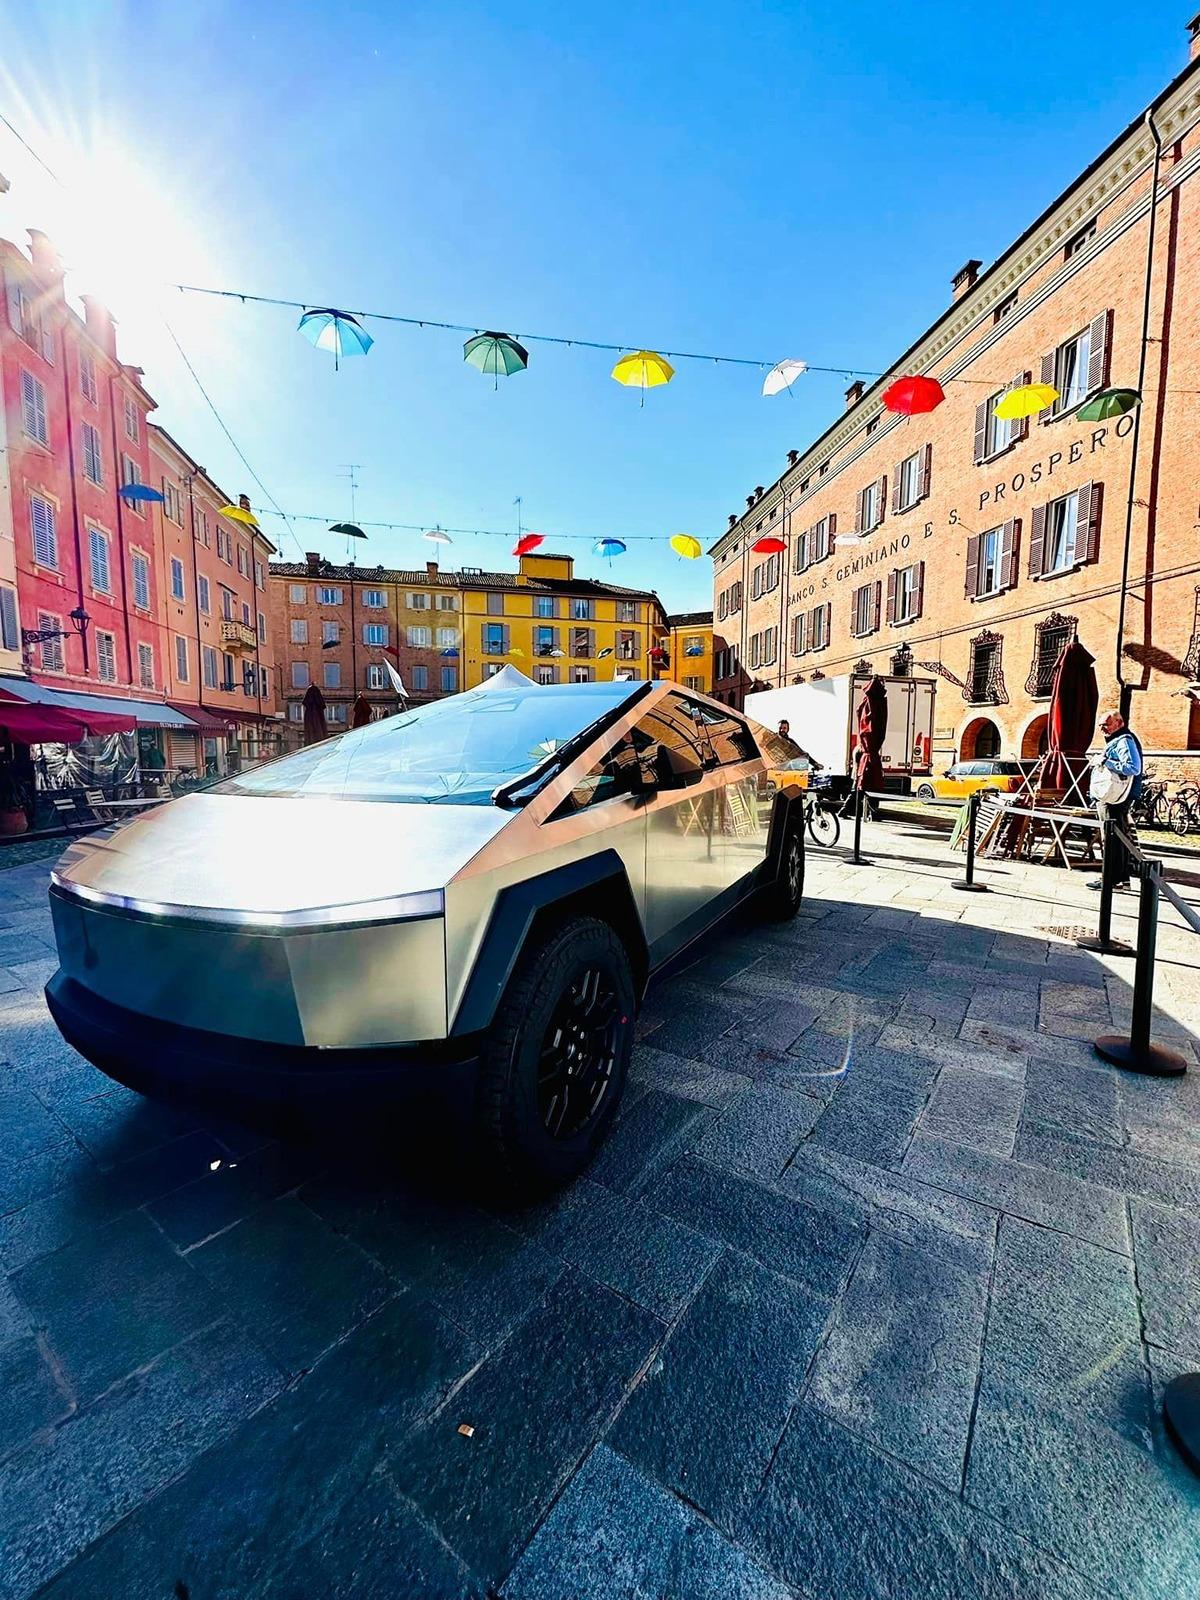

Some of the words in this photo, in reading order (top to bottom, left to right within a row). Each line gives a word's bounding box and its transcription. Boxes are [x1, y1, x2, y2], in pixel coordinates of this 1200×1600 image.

[836, 534, 911, 582] GEMINIANO
[923, 521, 934, 539] E
[948, 509, 962, 526] S.
[978, 415, 1135, 511] PROSPERO
